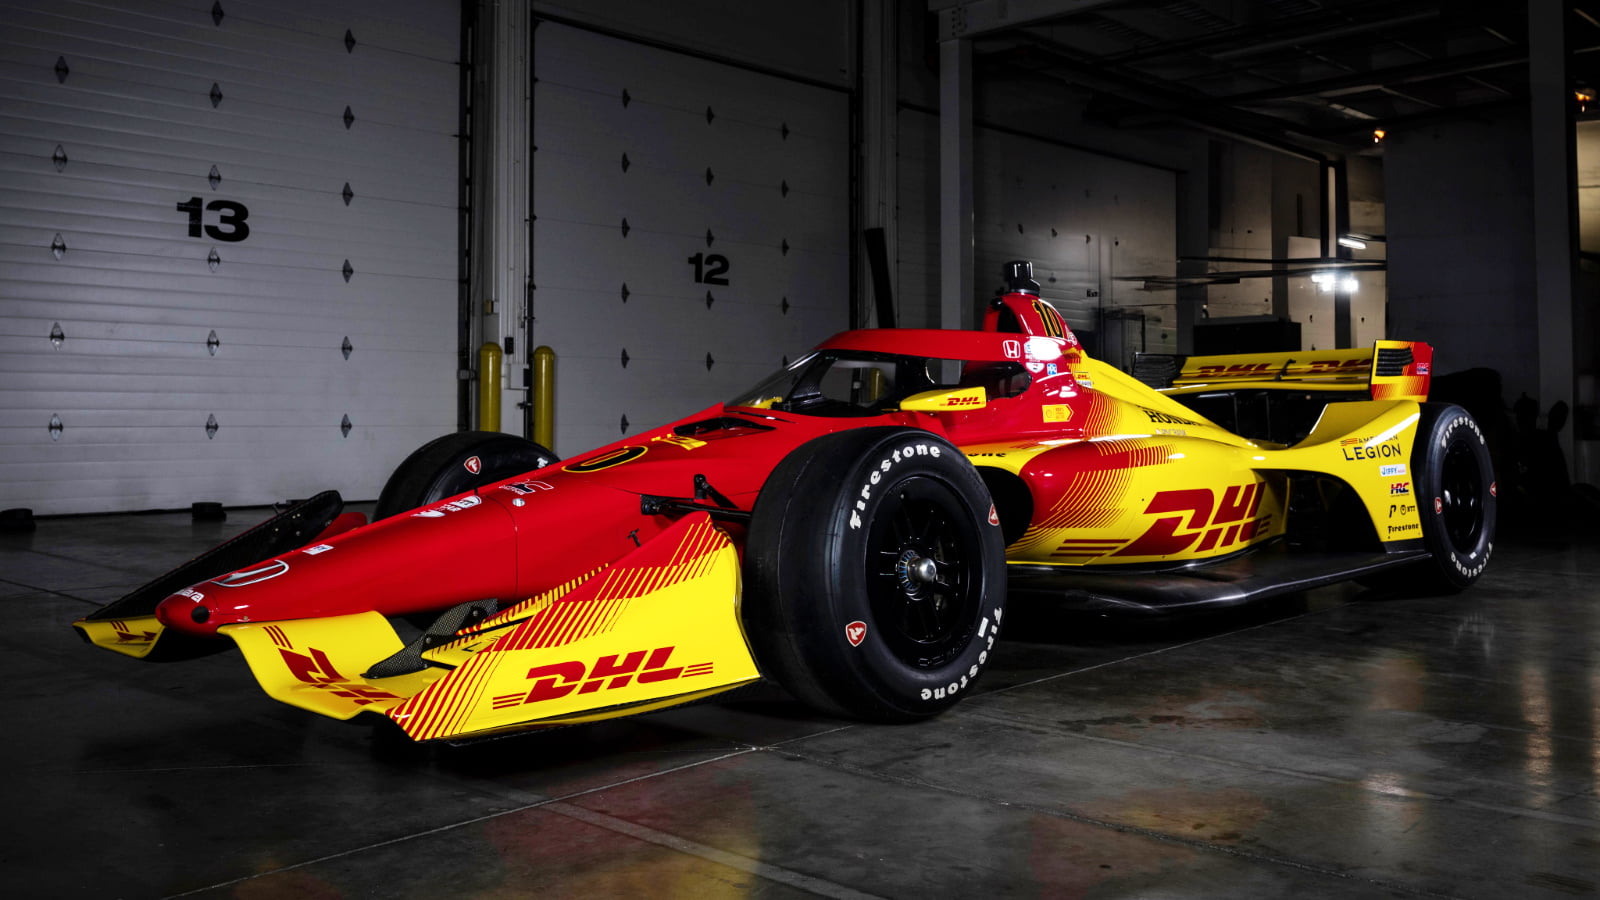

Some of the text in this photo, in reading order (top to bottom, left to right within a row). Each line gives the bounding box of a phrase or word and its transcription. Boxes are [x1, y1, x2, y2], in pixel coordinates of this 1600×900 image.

[177, 196, 250, 242] 13
[688, 253, 730, 286] 12
[1032, 300, 1064, 339] 10
[1307, 358, 1372, 373] DH
[947, 397, 981, 406] DHL
[1441, 416, 1485, 449] Firestone
[1342, 443, 1402, 461] LEGION
[850, 444, 941, 530] Firestone
[1390, 482, 1410, 494] HRC
[1108, 481, 1266, 557] DHL
[1388, 523, 1419, 534] Firestone
[921, 607, 1002, 700] Firestone
[523, 646, 684, 704] DHL
